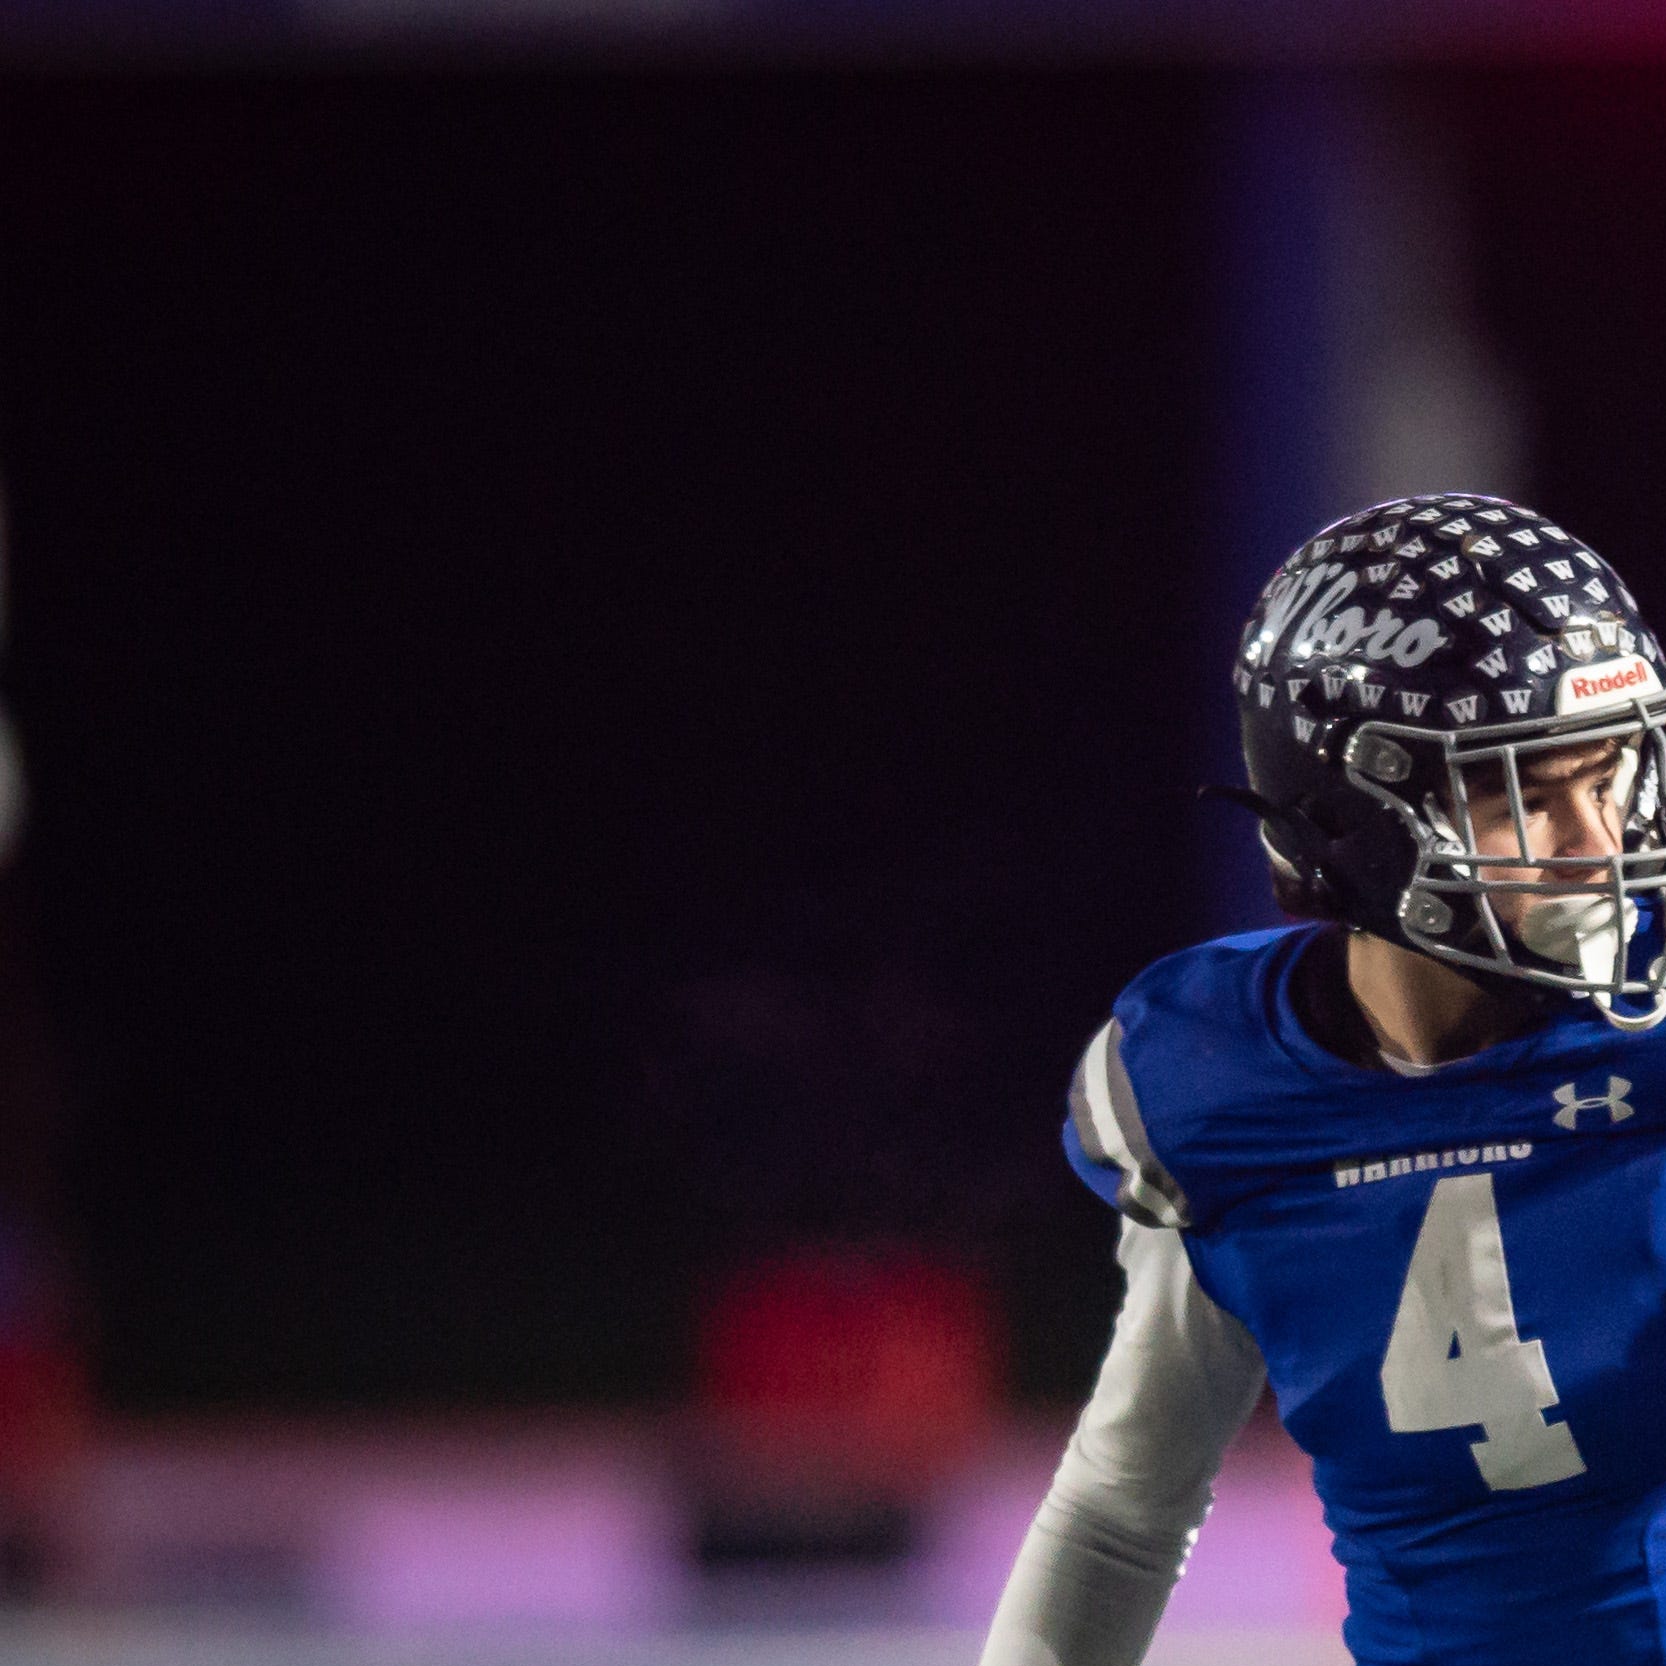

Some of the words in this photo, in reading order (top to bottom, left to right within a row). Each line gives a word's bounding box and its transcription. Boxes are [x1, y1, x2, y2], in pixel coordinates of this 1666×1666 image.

[1439, 518, 1472, 535] W
[1473, 509, 1508, 522] W
[1372, 524, 1400, 546] W
[1396, 536, 1426, 558] W
[1468, 536, 1502, 557] W
[1508, 529, 1540, 546] W
[1368, 562, 1397, 583] W
[1428, 556, 1461, 580] W
[1505, 567, 1538, 592] W
[1544, 560, 1575, 580] W
[1389, 574, 1420, 599] W
[1582, 577, 1610, 600] W
[1442, 591, 1476, 618] W
[1540, 595, 1570, 618] W
[1479, 609, 1513, 637] W
[1565, 630, 1596, 655] W
[1475, 647, 1508, 678] W
[1525, 644, 1557, 674] W
[1357, 683, 1386, 708] W
[1400, 691, 1431, 717] W
[1501, 689, 1532, 714] W
[1447, 695, 1478, 724] W
[1380, 1173, 1588, 1490] 4
